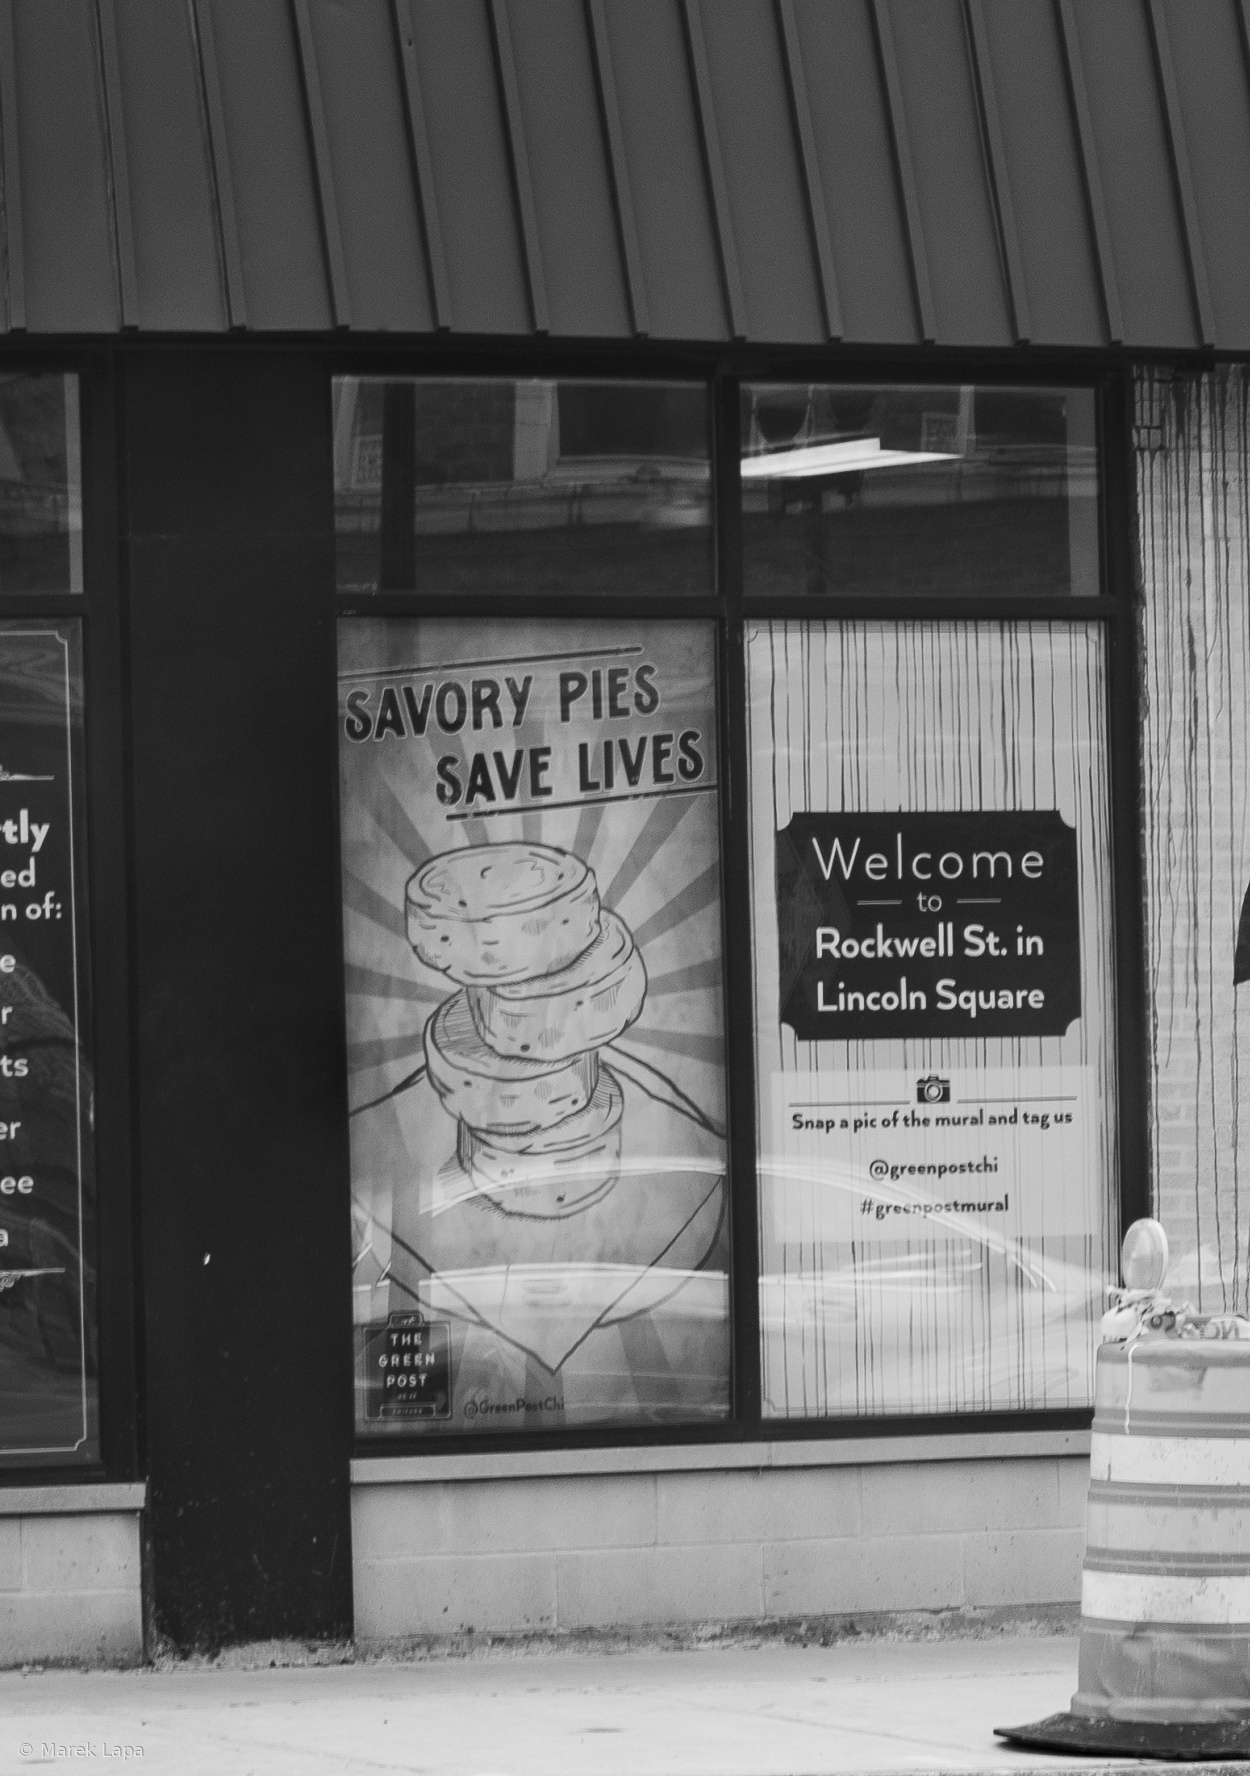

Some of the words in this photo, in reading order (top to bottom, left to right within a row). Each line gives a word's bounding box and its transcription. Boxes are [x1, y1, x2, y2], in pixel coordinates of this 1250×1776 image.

[344, 674, 532, 743] SAVORY
[559, 662, 660, 724] PIES
[435, 744, 553, 807] SAVE
[577, 728, 705, 794] LIVES
[0, 807, 51, 853] tly
[811, 831, 1045, 881] Welcome
[25, 890, 63, 921] of:
[916, 891, 943, 912] to
[815, 921, 954, 959] Rockwell
[963, 923, 1008, 957] St.
[1015, 924, 1045, 957] in
[816, 976, 928, 1013] Lincoln
[935, 978, 1046, 1018] Square
[791, 1112, 836, 1134] Snap
[839, 1119, 849, 1129] a
[853, 1111, 878, 1134] pic
[881, 1109, 899, 1129] of
[902, 1108, 932, 1128] the
[935, 1108, 984, 1127] mural
[988, 1107, 1018, 1126] and
[1022, 1112, 1050, 1130] tag
[1053, 1112, 1073, 1125] us
[869, 1155, 999, 1181] @greenpostchi
[860, 1193, 1009, 1220] #greenpostmural
[390, 1332, 423, 1347] THE
[378, 1352, 436, 1368] GREEN
[386, 1372, 428, 1389] POST
